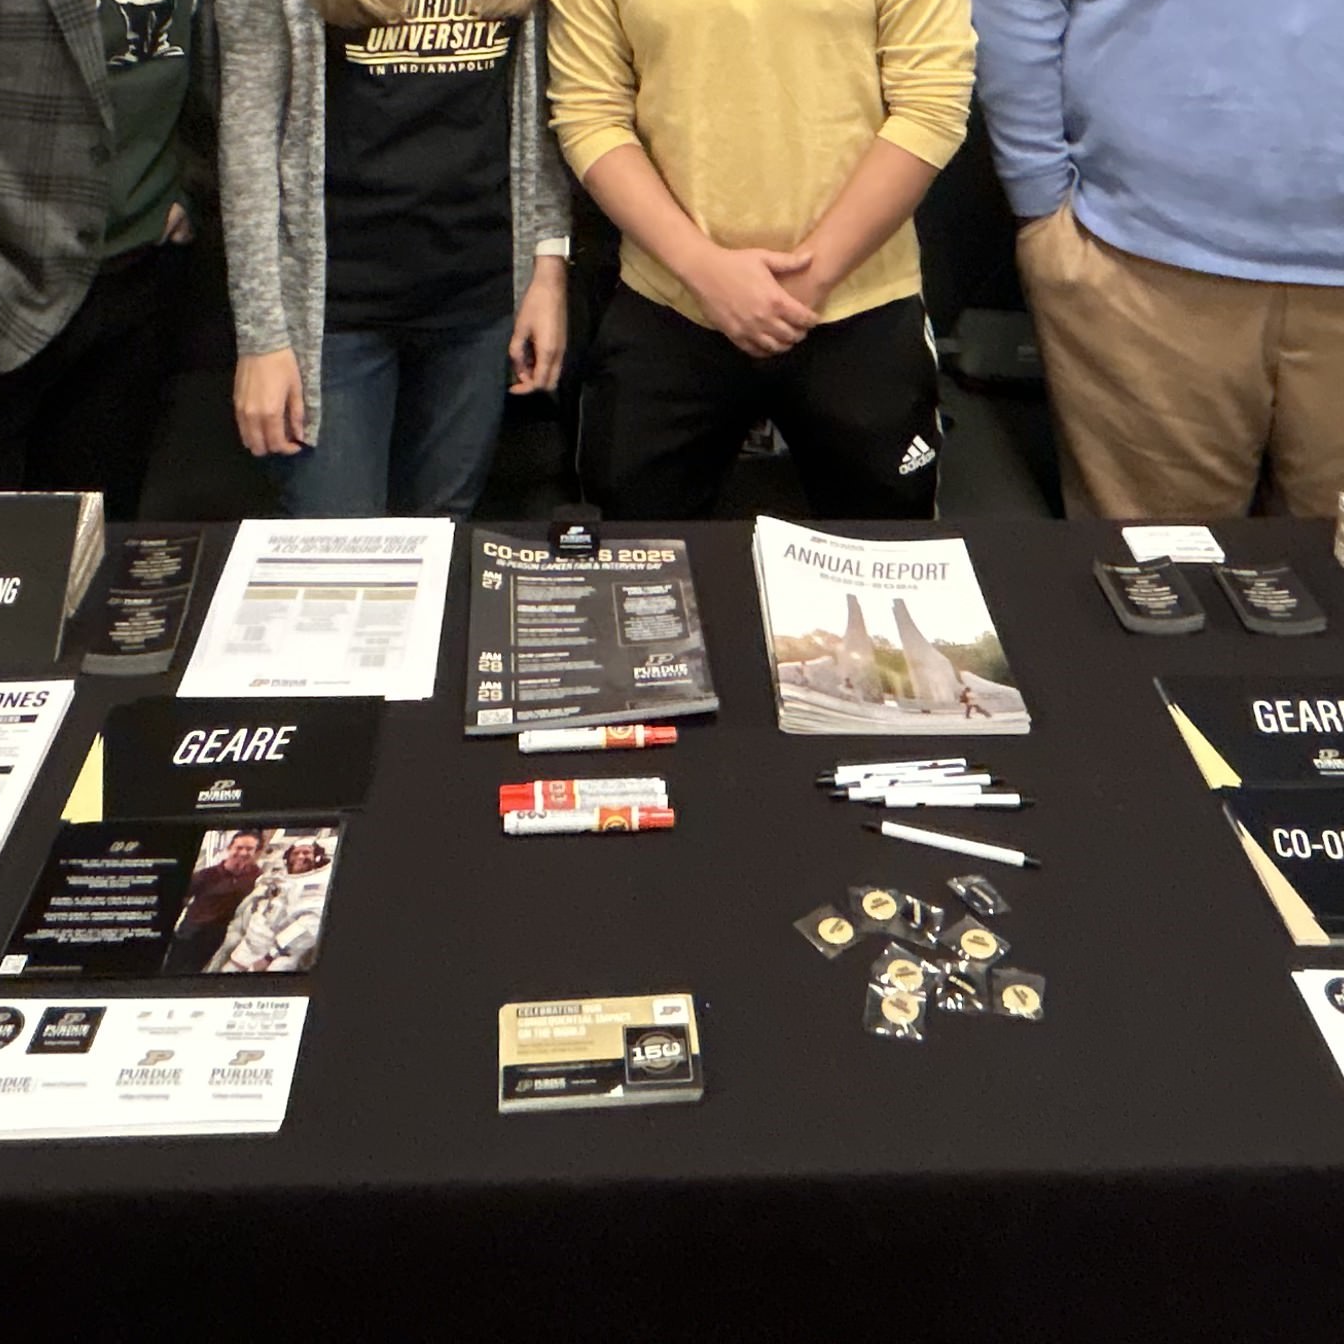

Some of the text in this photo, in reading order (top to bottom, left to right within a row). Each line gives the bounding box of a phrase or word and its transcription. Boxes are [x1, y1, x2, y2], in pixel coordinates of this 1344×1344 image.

[367, 22, 499, 52] UNIVERSITY
[369, 60, 495, 76] IN INDIANAPOLIS
[483, 542, 550, 563] CO-OP
[618, 549, 676, 563] 2025
[783, 543, 866, 579] ANNUAL
[871, 561, 950, 581] REPORT
[483, 570, 502, 580] JAN
[482, 578, 502, 590] 27
[480, 651, 502, 661] JAN
[478, 680, 503, 690] JAN
[172, 725, 298, 765] GEARE
[632, 1042, 681, 1063] 150
[117, 1068, 184, 1079] PURDUE
[211, 1068, 275, 1079] PURDUE
